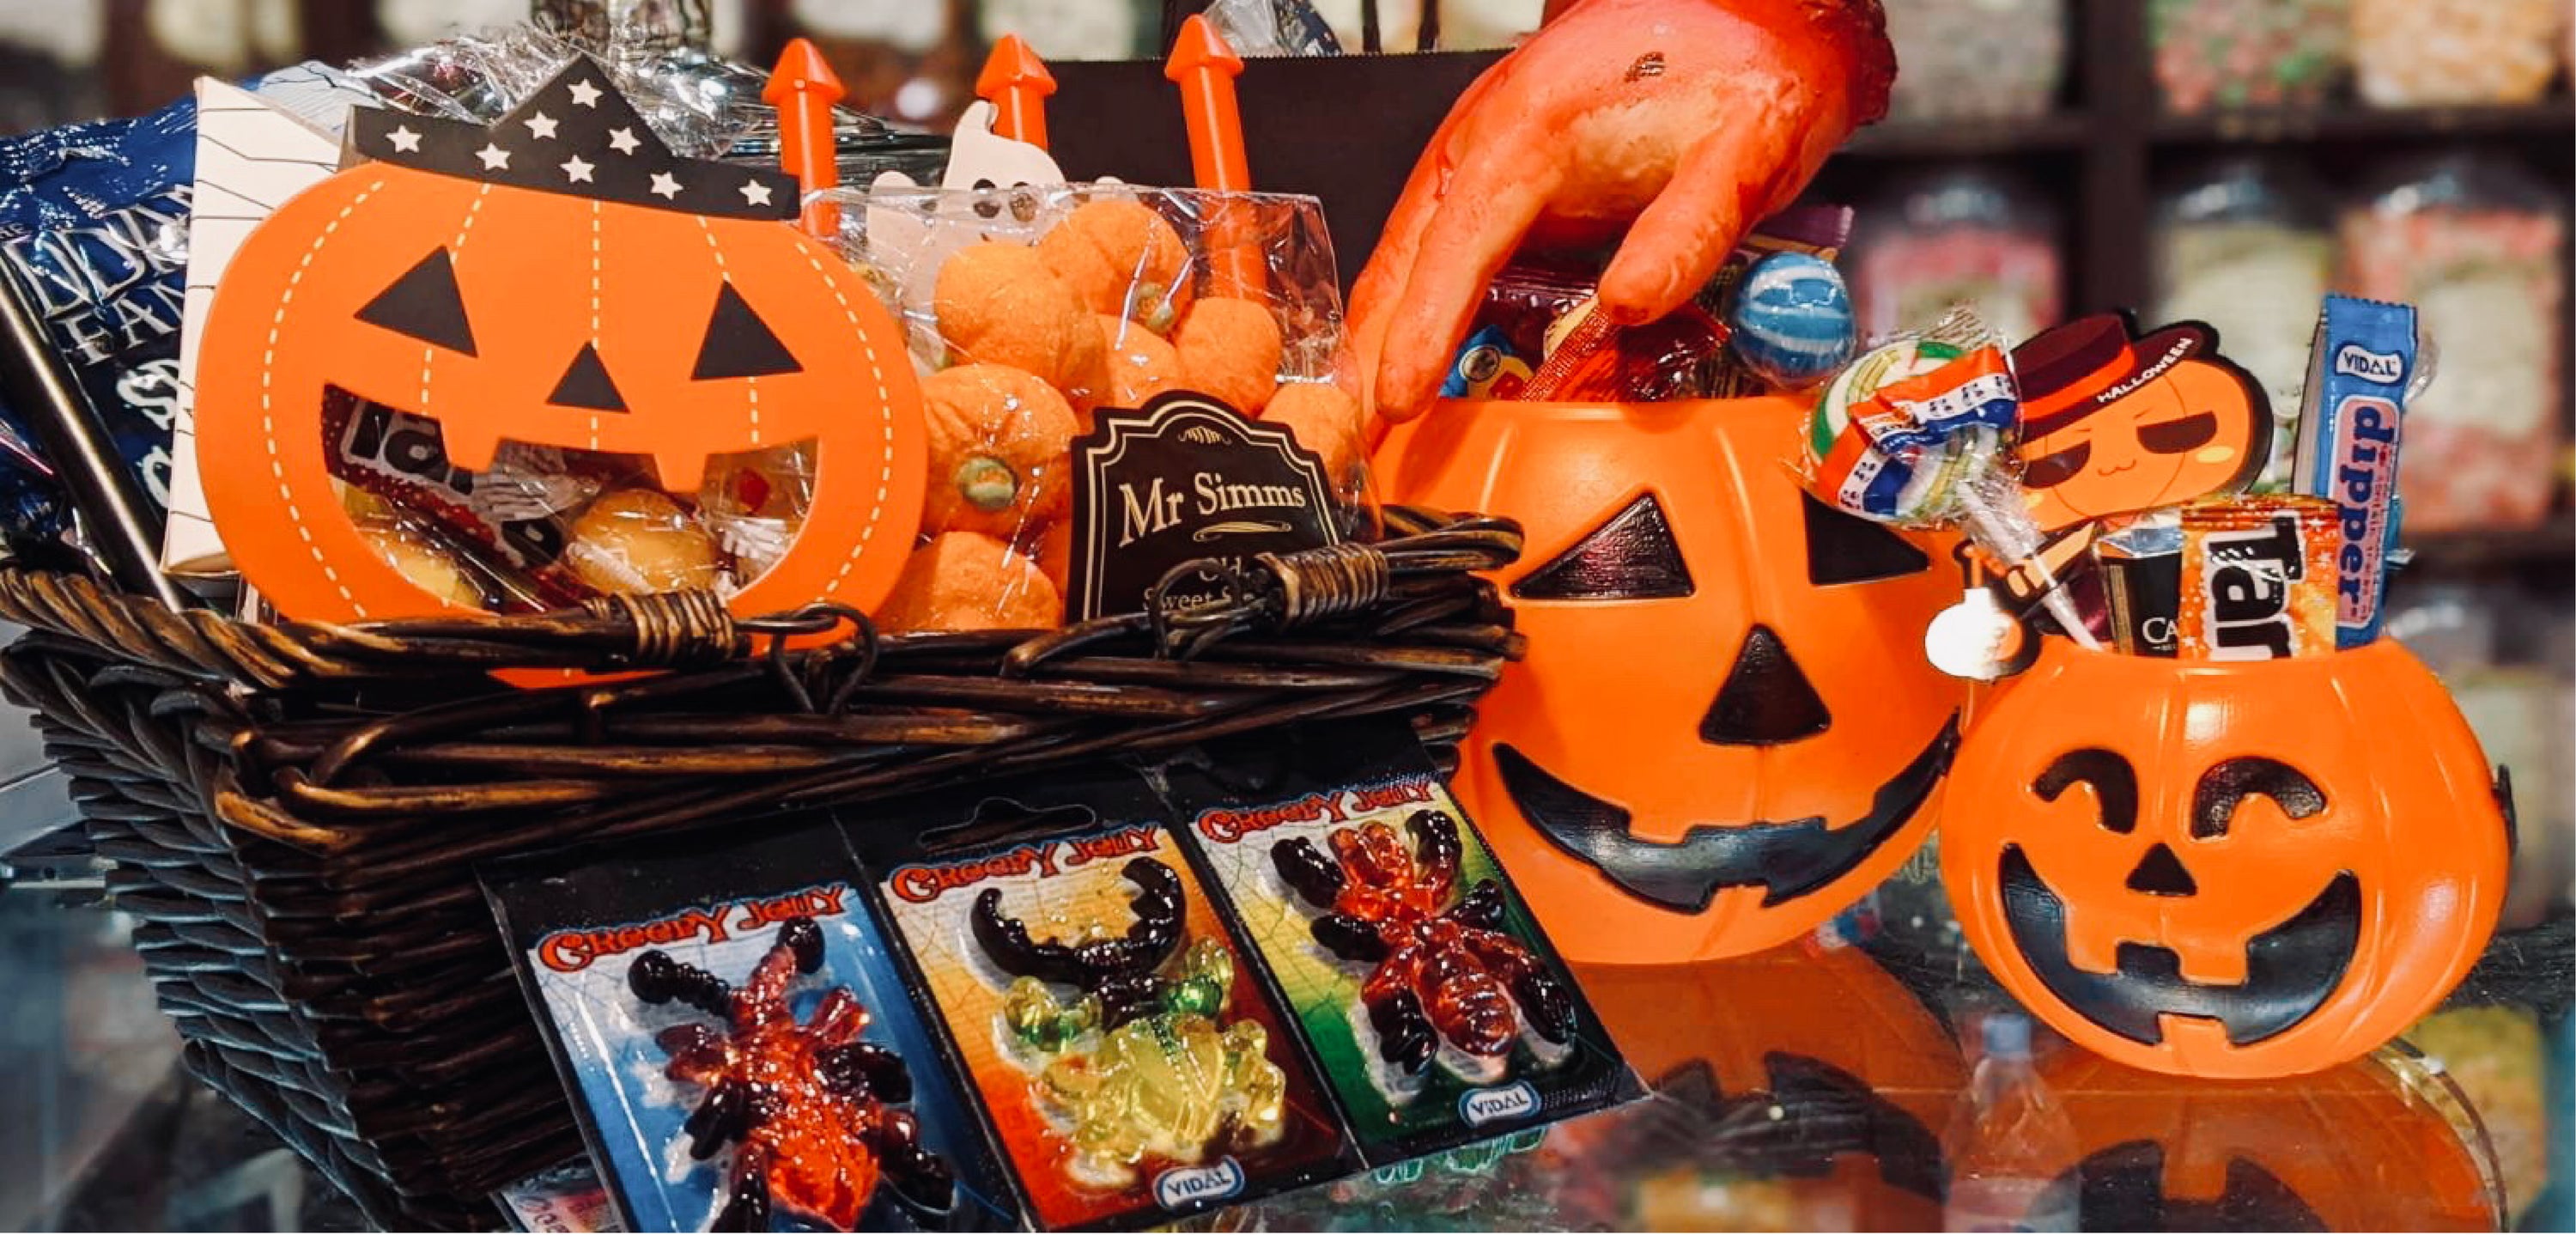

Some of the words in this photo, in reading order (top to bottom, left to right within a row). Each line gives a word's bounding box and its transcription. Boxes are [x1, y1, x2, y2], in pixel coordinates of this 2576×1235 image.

[2097, 338, 2193, 403] HALLOWEEN
[2343, 350, 2397, 377] VIDAL
[1118, 477, 1185, 548] Mr
[1194, 471, 1306, 515] Simms
[2338, 405, 2395, 605] dipper
[1470, 1091, 1529, 1116] VIDAL
[1167, 1170, 1232, 1196] VIDAL
